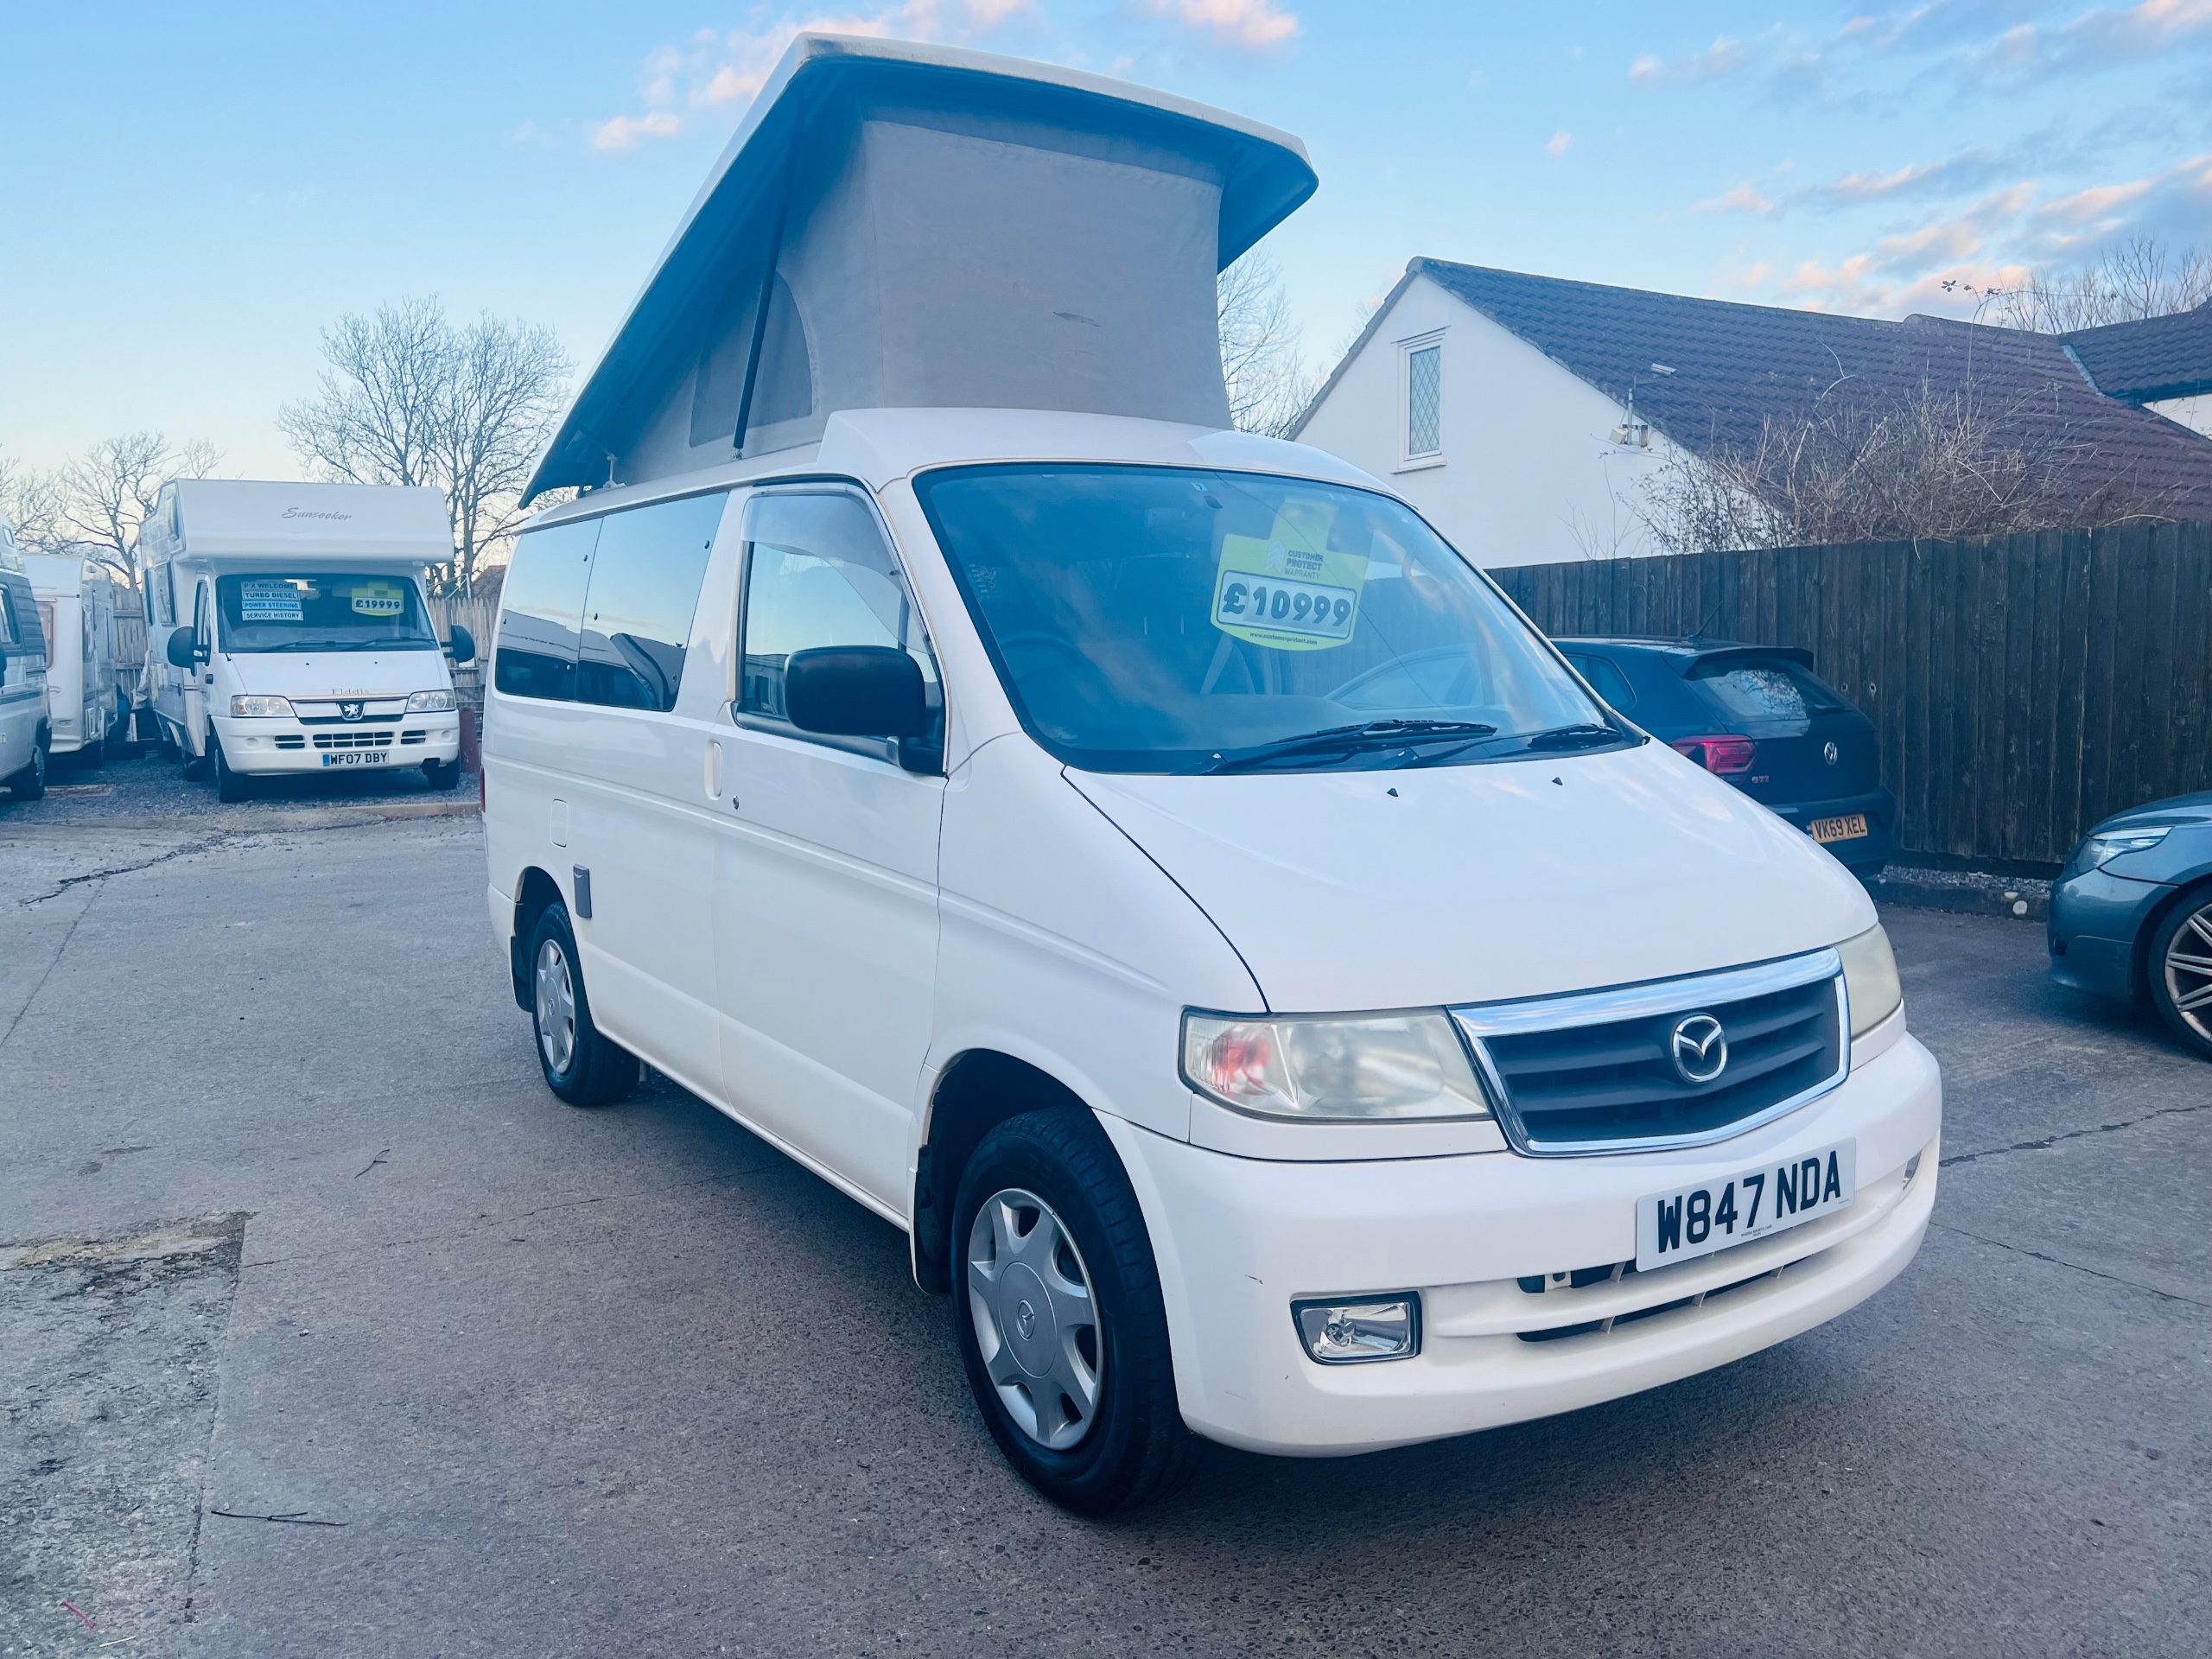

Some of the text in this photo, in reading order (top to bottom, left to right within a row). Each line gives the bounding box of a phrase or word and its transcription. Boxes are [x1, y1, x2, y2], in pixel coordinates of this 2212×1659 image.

[1287, 550, 1324, 562] CUSTOMER
[1286, 558, 1322, 571] PROTECT
[1284, 568, 1320, 580] WARRANTY
[355, 599, 400, 609] £19999
[1222, 582, 1351, 627] £10999
[1249, 632, 1318, 645] www.customerprotect.com
[330, 752, 387, 765] WF07 DBY
[1751, 775, 1770, 784] GTI
[1815, 816, 1866, 839] VK69 XEL
[1657, 1150, 1841, 1254] W847 NDA
